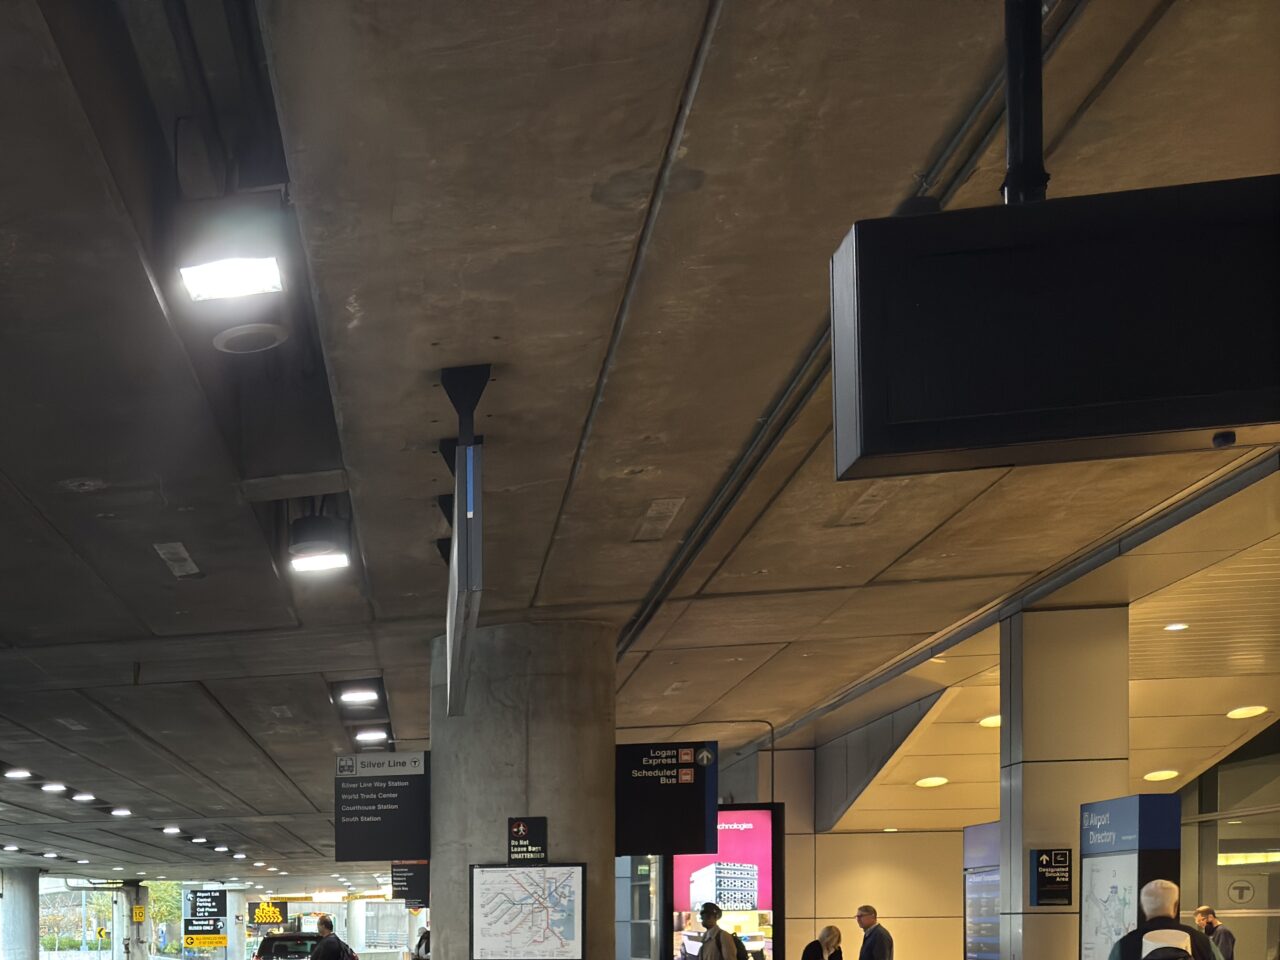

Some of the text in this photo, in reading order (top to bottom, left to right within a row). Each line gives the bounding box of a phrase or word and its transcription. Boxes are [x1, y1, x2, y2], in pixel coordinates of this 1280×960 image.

[650, 749, 677, 758] Logan
[360, 760, 385, 769] Silver
[388, 760, 407, 768] Line
[642, 758, 677, 766] Express
[631, 769, 677, 778] Scheduled
[1090, 812, 1110, 828] Airport
[717, 822, 753, 830] chnologies
[1090, 832, 1116, 845] Directory
